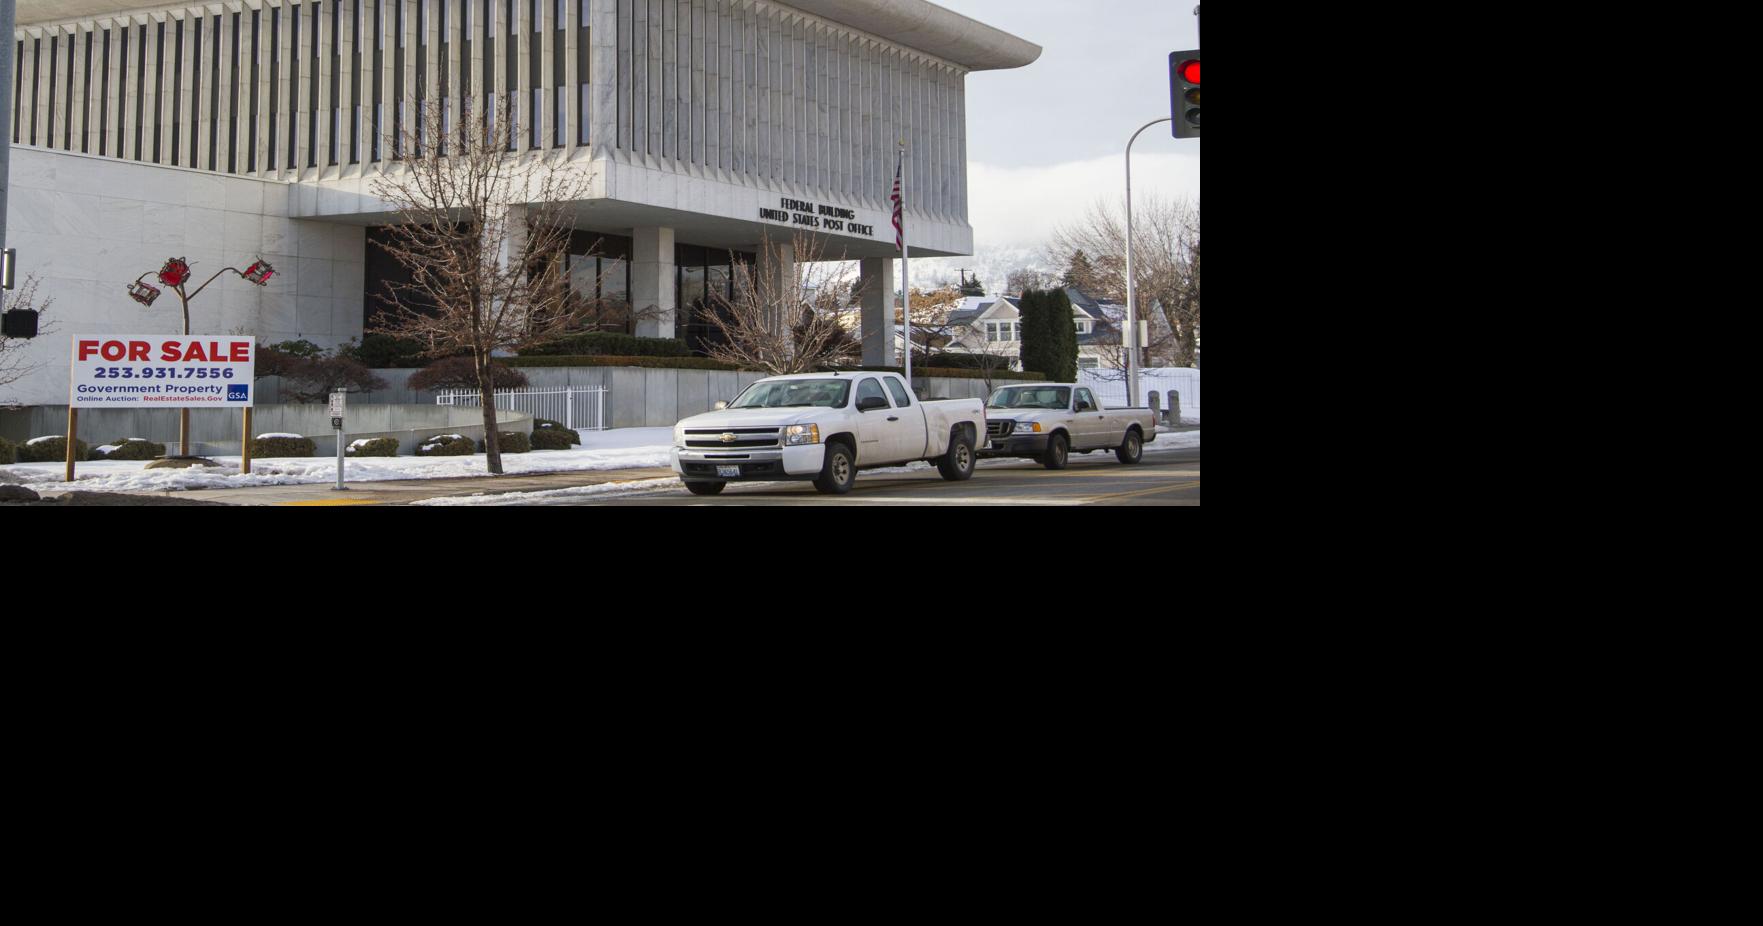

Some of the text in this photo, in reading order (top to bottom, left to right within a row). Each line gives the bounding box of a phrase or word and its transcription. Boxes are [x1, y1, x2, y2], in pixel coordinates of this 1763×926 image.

[781, 198, 855, 219] FEDERAL BUILDING
[760, 208, 873, 236] UNITED STATES POST OFFICE
[78, 340, 249, 362] FOR SALE
[94, 367, 234, 379] 253.931.7556
[77, 384, 223, 395] Government Property
